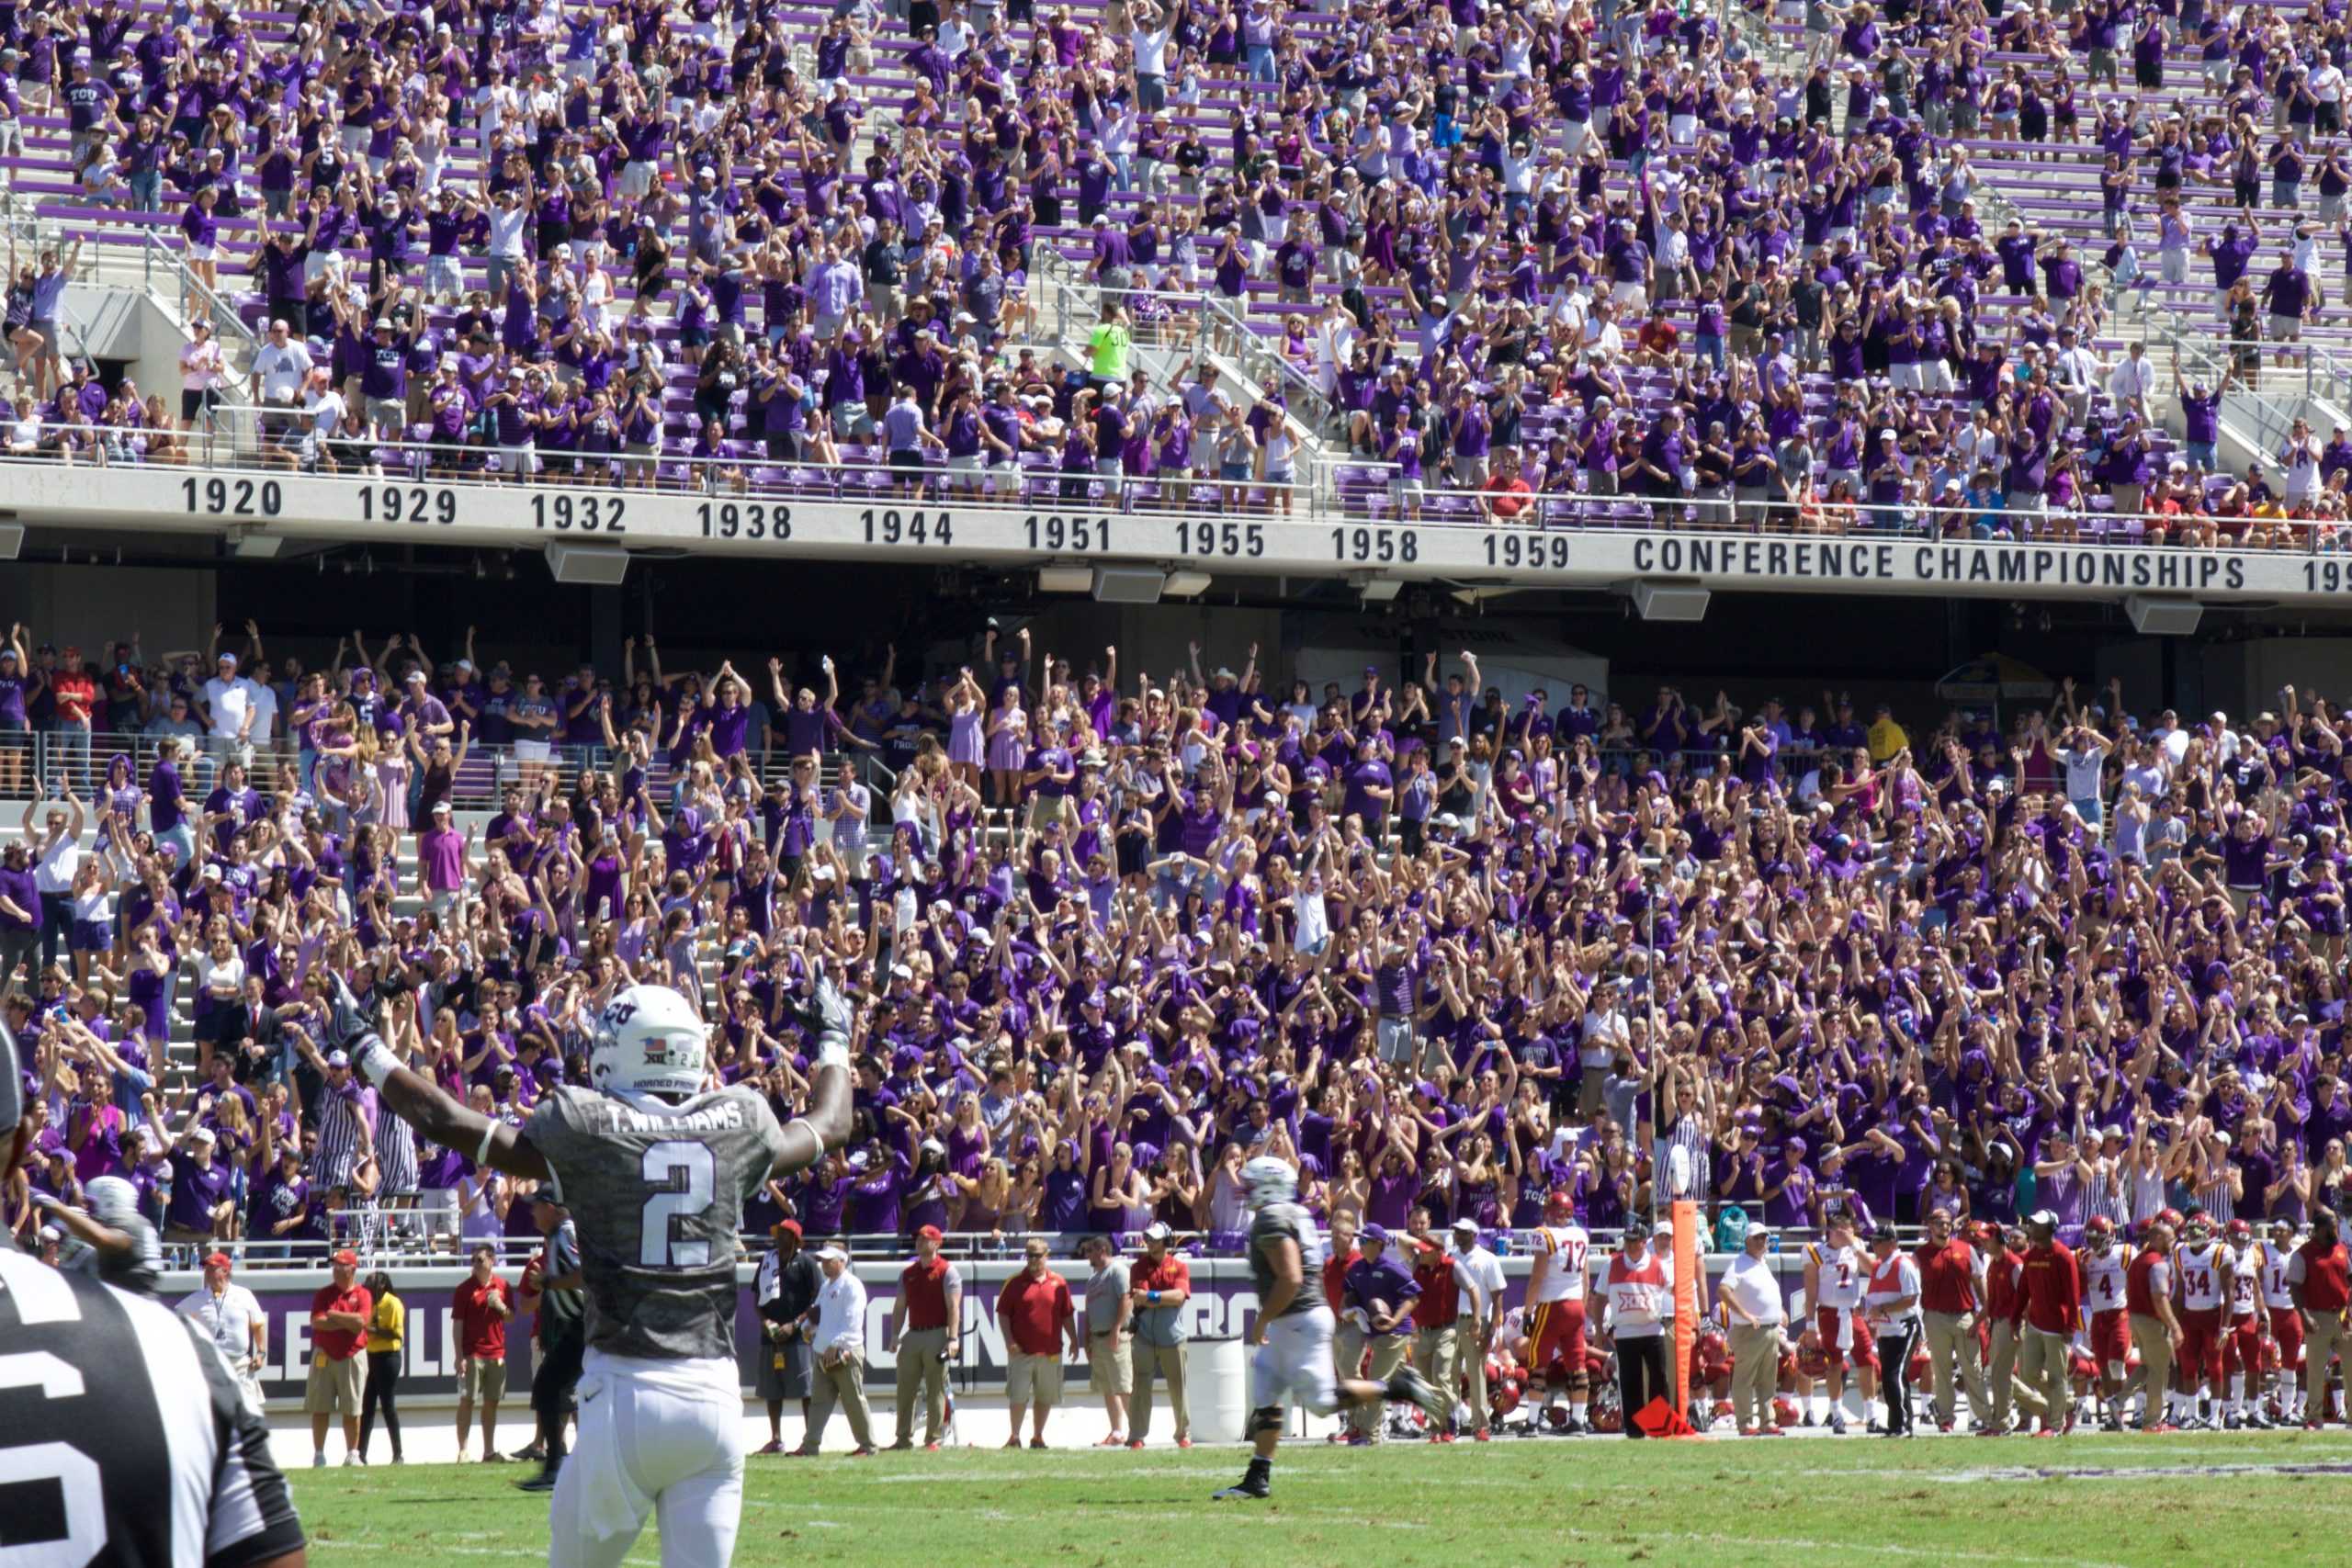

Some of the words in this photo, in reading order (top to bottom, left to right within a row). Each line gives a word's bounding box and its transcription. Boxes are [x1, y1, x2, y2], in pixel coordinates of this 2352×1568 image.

[71, 89, 98, 101] TCU
[322, 146, 334, 165] 5
[1702, 304, 1724, 315] TCU
[1111, 331, 1128, 347] 30
[376, 349, 400, 361] TCU
[183, 477, 281, 516] 1920
[359, 486, 456, 525] 1929
[532, 494, 626, 532] 1932
[697, 502, 791, 540] 1938
[861, 509, 953, 546] 1944
[1024, 515, 1109, 551] 1951
[1176, 522, 1264, 558] 1955
[1331, 527, 1418, 563] 1958
[1484, 534, 1568, 569] 1959
[1634, 538, 1894, 578] CONFERENCE
[1915, 547, 2245, 591] CHAMPIONSHIPS
[360, 705, 374, 725] 5
[2238, 766, 2252, 785] 5
[633, 1078, 673, 1089] HORNED
[605, 1101, 743, 1133] T.WILLIAMS
[641, 1141, 715, 1267] 2
[1522, 1188, 1545, 1206] TCU
[2098, 1274, 2112, 1301] 4
[2184, 1270, 2211, 1296] 34
